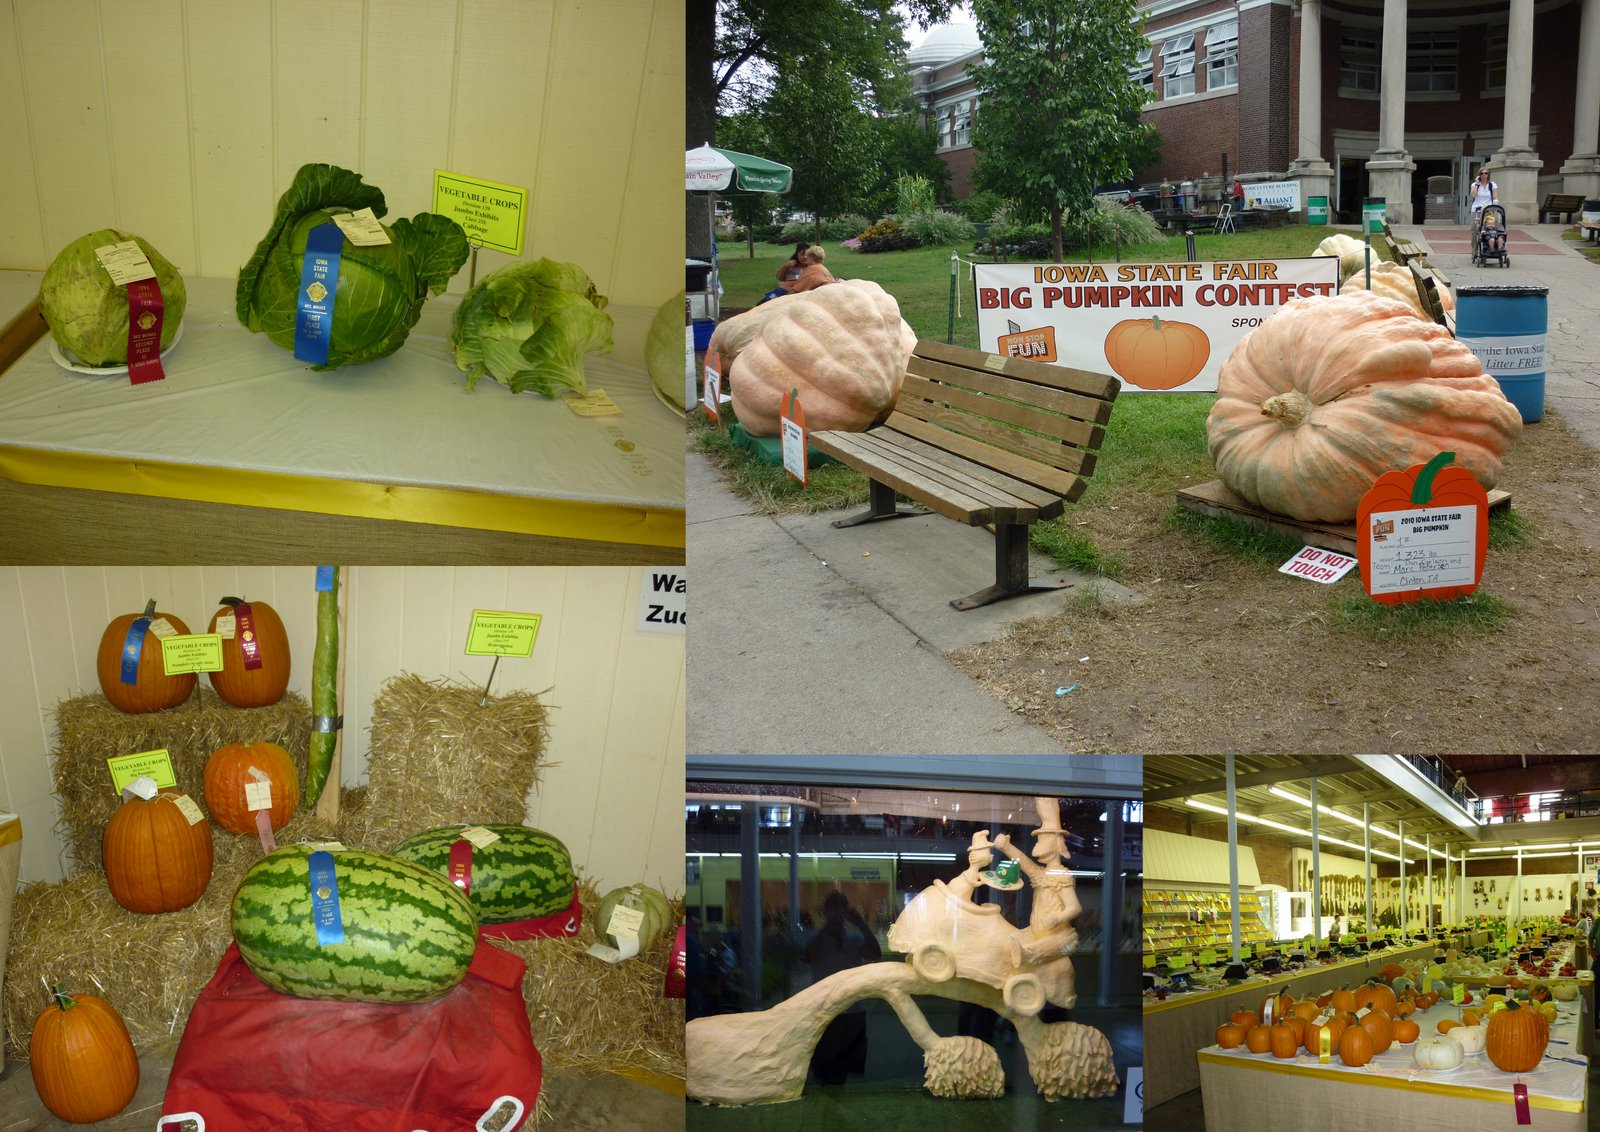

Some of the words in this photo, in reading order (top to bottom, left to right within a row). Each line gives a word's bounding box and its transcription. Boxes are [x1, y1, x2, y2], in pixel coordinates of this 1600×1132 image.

[440, 186, 488, 203] VEGETABLE
[489, 198, 519, 210] CROPS
[1264, 197, 1293, 205] ALLIANT
[454, 206, 474, 215] Jumbo
[475, 210, 499, 221] Exhibits
[462, 222, 488, 234] Cabbage
[313, 265, 328, 273] STATE
[1034, 265, 1108, 283] IOWA
[1117, 264, 1202, 282] STATE
[1213, 262, 1278, 281] FAIR
[979, 287, 1032, 309] BIG
[1042, 285, 1184, 309] PUMPKIN
[1195, 283, 1335, 307] CONTEST
[1007, 336, 1024, 345] NON
[1025, 334, 1045, 342] STOP
[1008, 341, 1048, 358] FUN
[1486, 347, 1502, 356] the
[1505, 347, 1530, 355] Iowa
[1486, 359, 1516, 368] Litter
[1400, 517, 1415, 525] 2010
[1415, 516, 1430, 524] IOWA
[1423, 524, 1449, 533] PUMPKIN
[1298, 548, 1323, 561] DO
[1319, 553, 1354, 570] NOT
[1287, 560, 1337, 581] TOUCH
[1393, 565, 1414, 575] Marc
[477, 622, 513, 630] VEGETABLE
[166, 643, 198, 651] VEGETABLE
[113, 761, 147, 772] VEGETABLE
